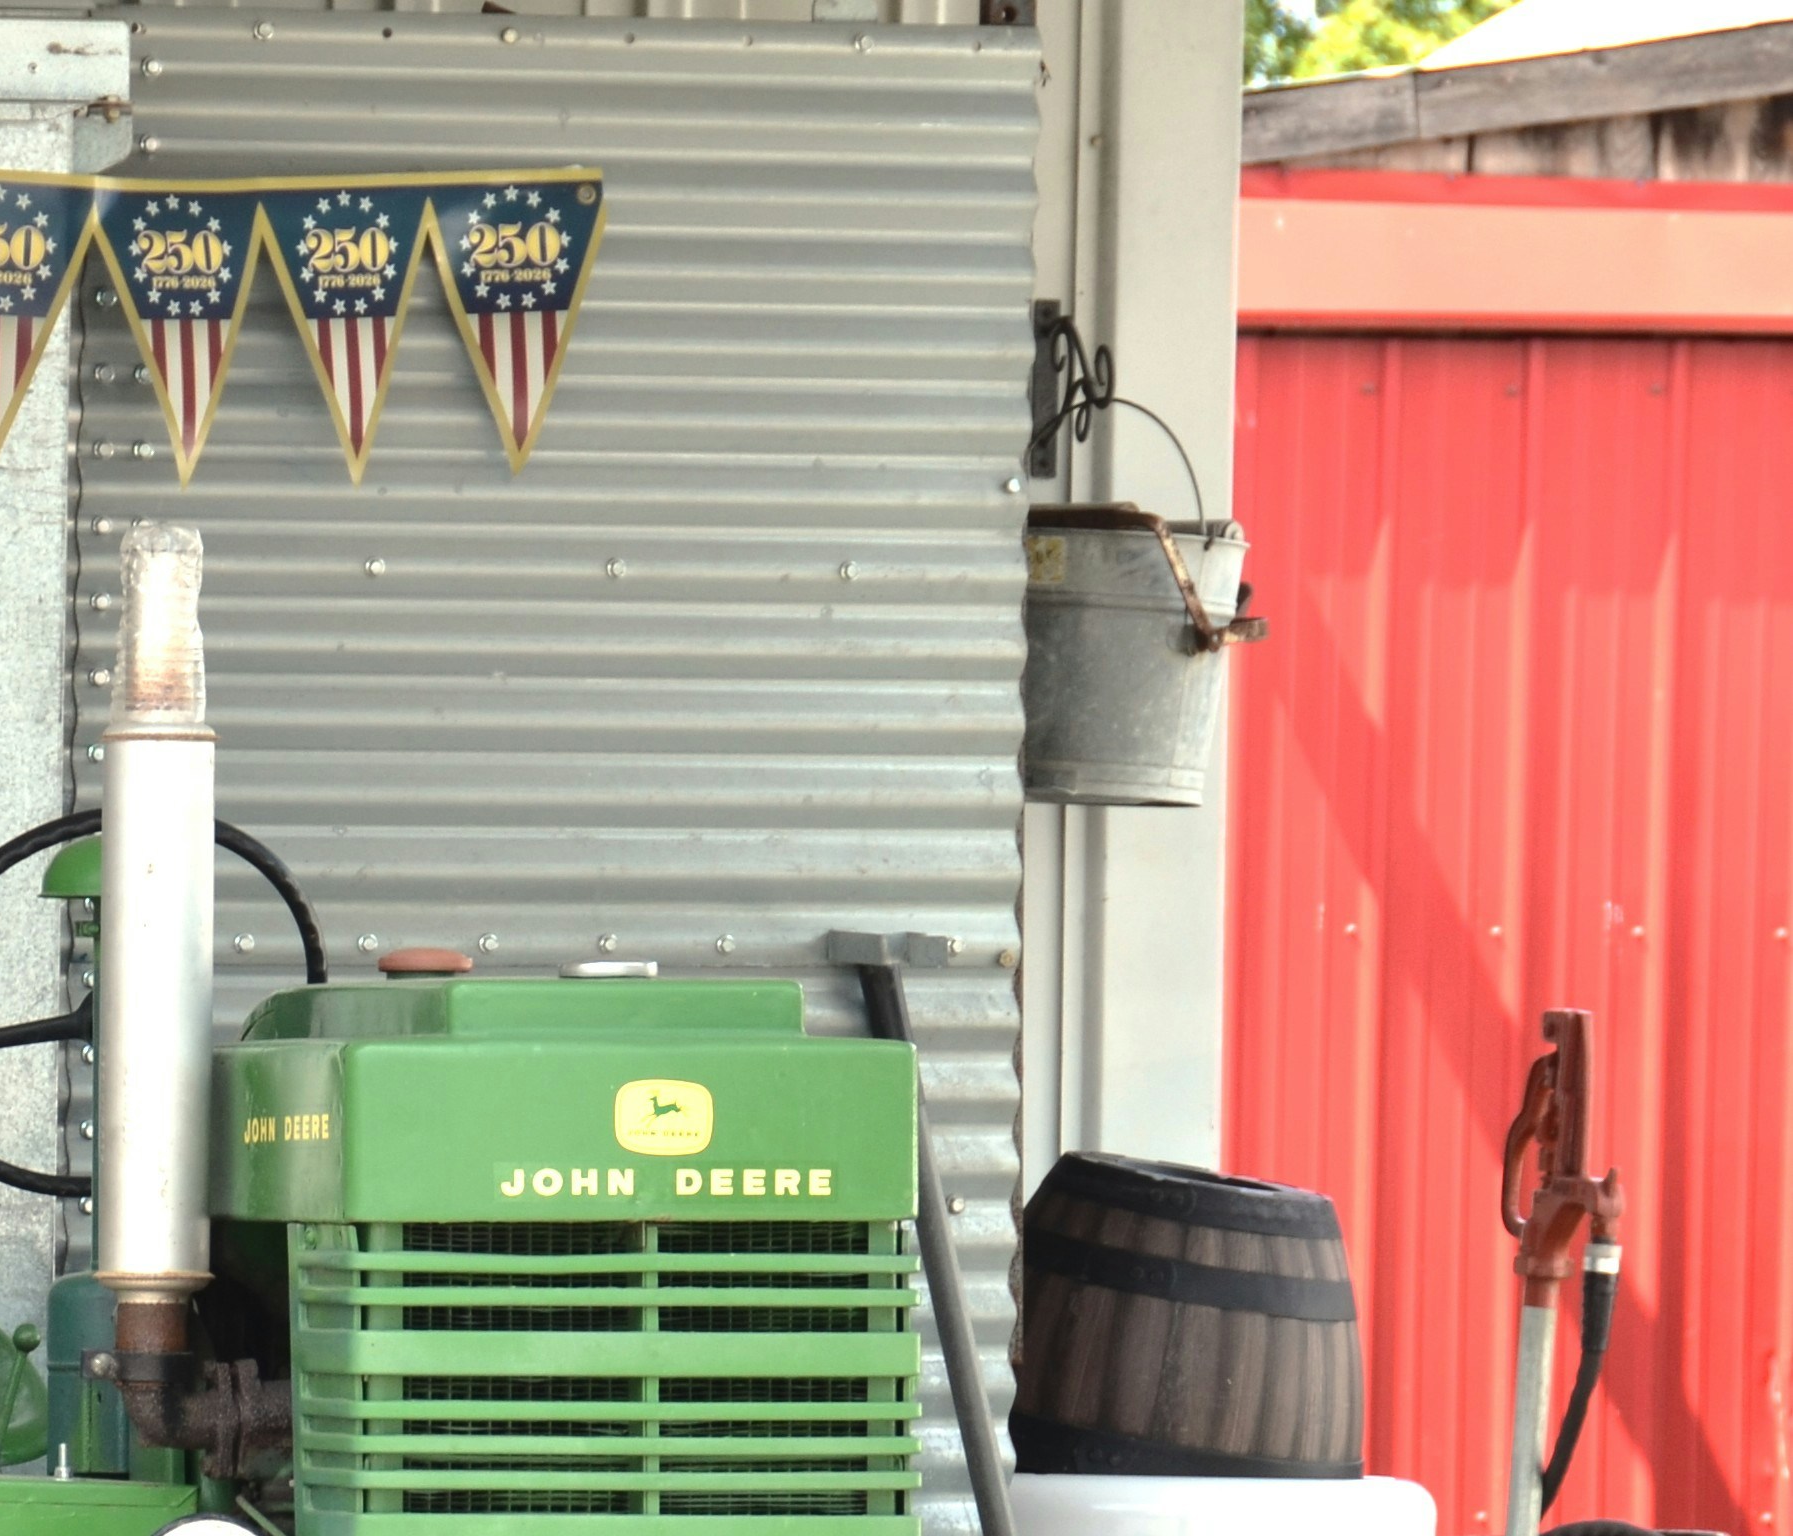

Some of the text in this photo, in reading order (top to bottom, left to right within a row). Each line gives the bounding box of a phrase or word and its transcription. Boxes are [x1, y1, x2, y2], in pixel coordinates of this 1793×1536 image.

[137, 230, 224, 274] 250
[306, 227, 390, 272] 250
[468, 222, 562, 270] 250
[243, 1112, 330, 1144] JOHN DEERE
[500, 1168, 833, 1196] JOHN DEERE
